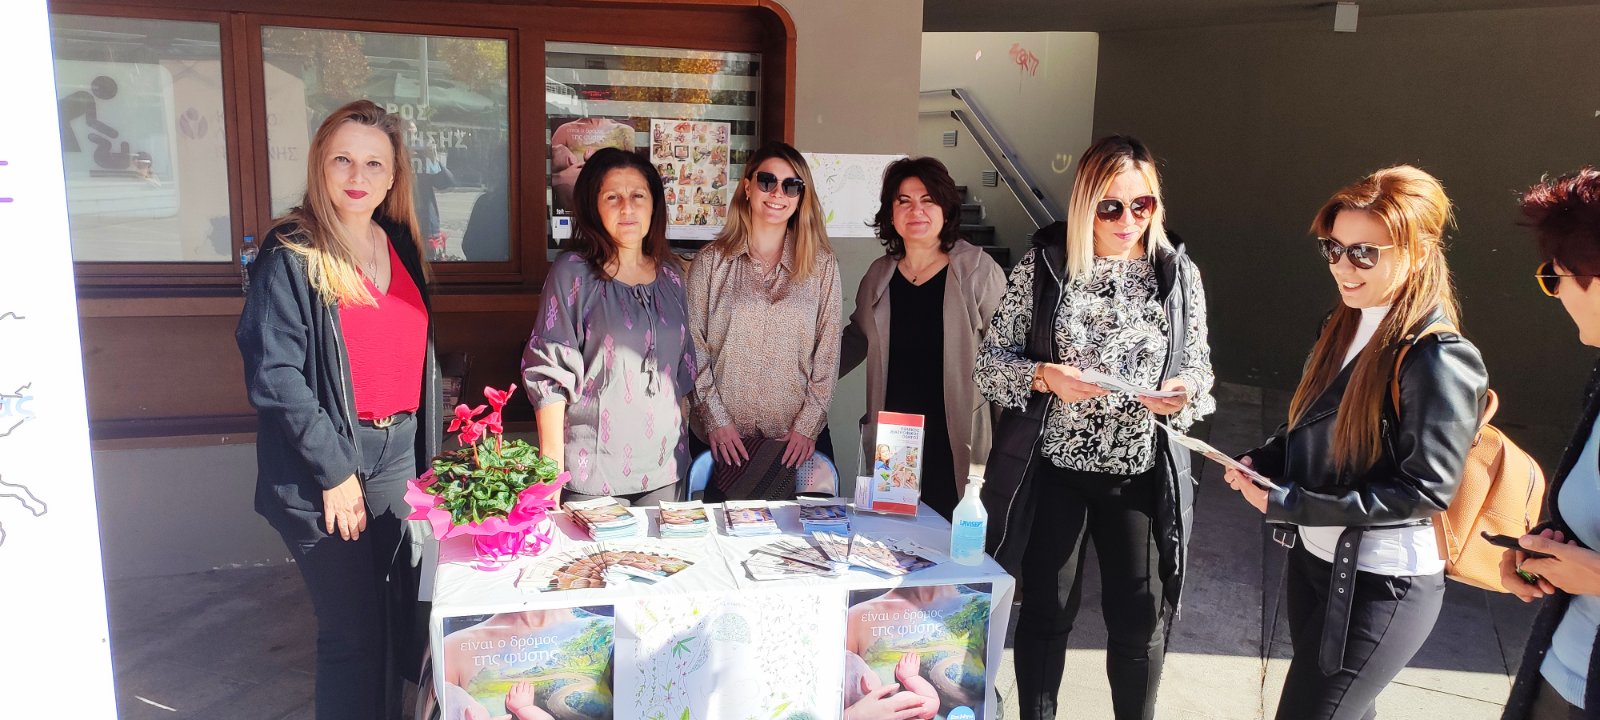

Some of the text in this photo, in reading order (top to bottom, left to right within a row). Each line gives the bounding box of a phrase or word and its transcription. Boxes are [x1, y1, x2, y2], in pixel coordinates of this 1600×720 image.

[403, 131, 467, 149] ΗΣΗΣ
[861, 607, 944, 622] είναι ο δρόμος
[870, 620, 943, 638] της φύσης
[460, 633, 558, 651] είναι ο δρόμος
[472, 647, 561, 667] της φύσης
